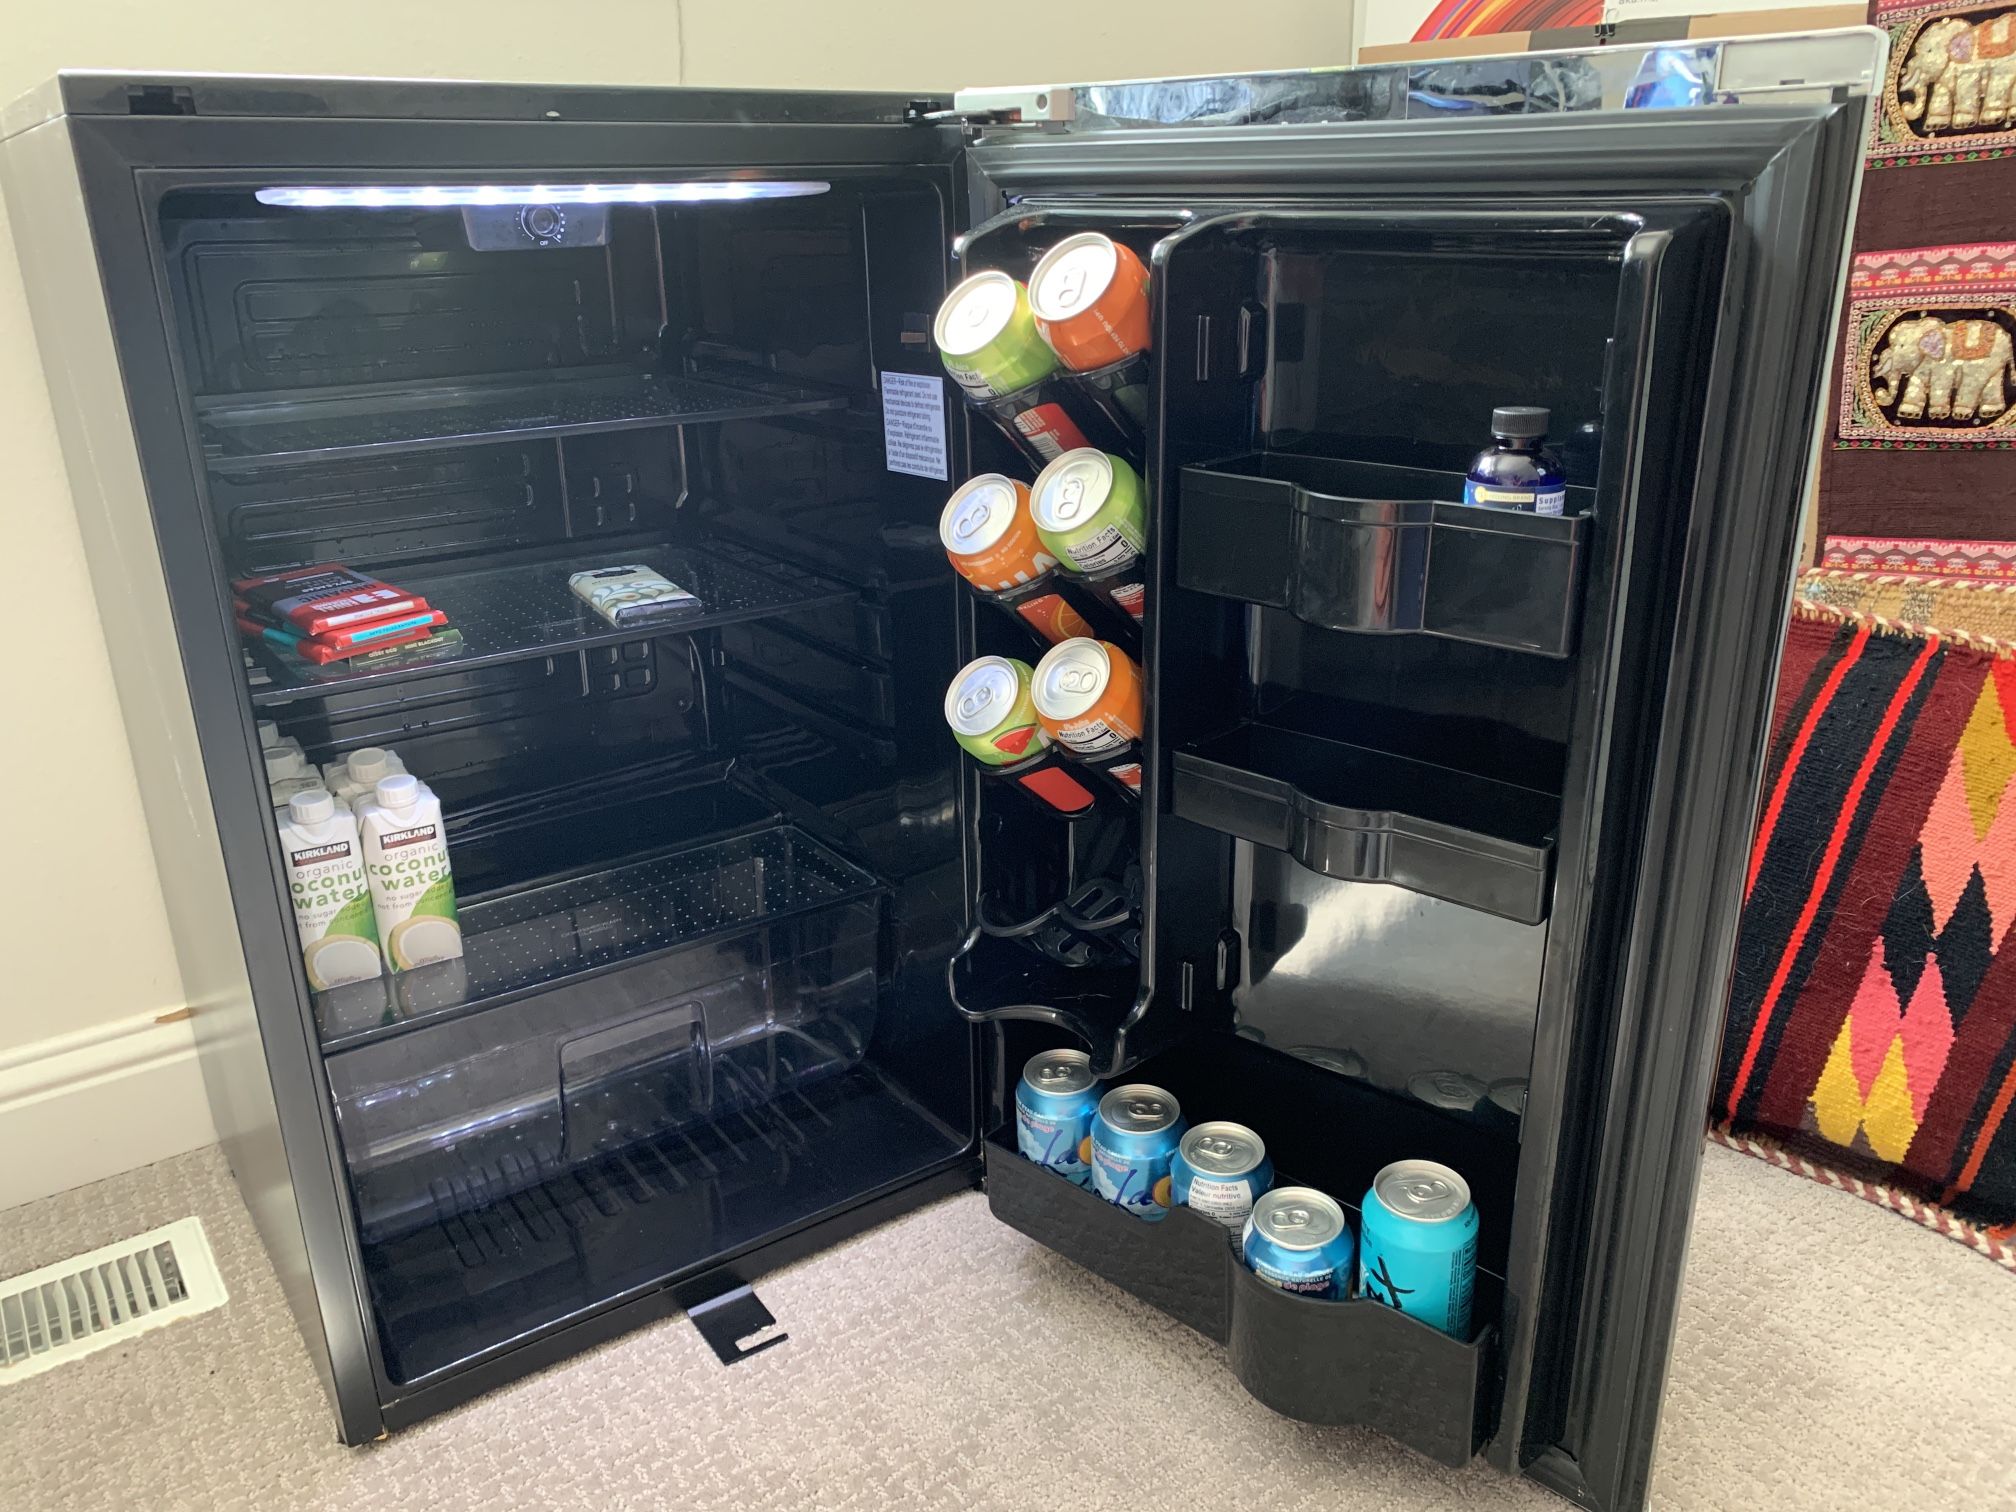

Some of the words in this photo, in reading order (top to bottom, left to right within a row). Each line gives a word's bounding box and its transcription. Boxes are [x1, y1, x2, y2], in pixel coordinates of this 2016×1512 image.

[1068, 542, 1096, 554] Nutrition
[1096, 528, 1116, 544] Facts
[1086, 722, 1104, 734] Facts
[383, 826, 434, 844] KIRKLAND
[294, 843, 348, 861] KIRKLAND
[385, 843, 438, 861] organic
[296, 860, 353, 879] organic
[381, 865, 447, 891] water
[293, 884, 362, 909] water
[400, 890, 422, 900] sugar
[313, 908, 337, 919] sugar
[1036, 1129, 1079, 1177] La
[1108, 1169, 1153, 1217] La
[1192, 1186, 1211, 1197] Valeur
[1194, 1178, 1219, 1190] Nutrition
[1283, 1281, 1298, 1290] de
[1299, 1280, 1330, 1293] plage
